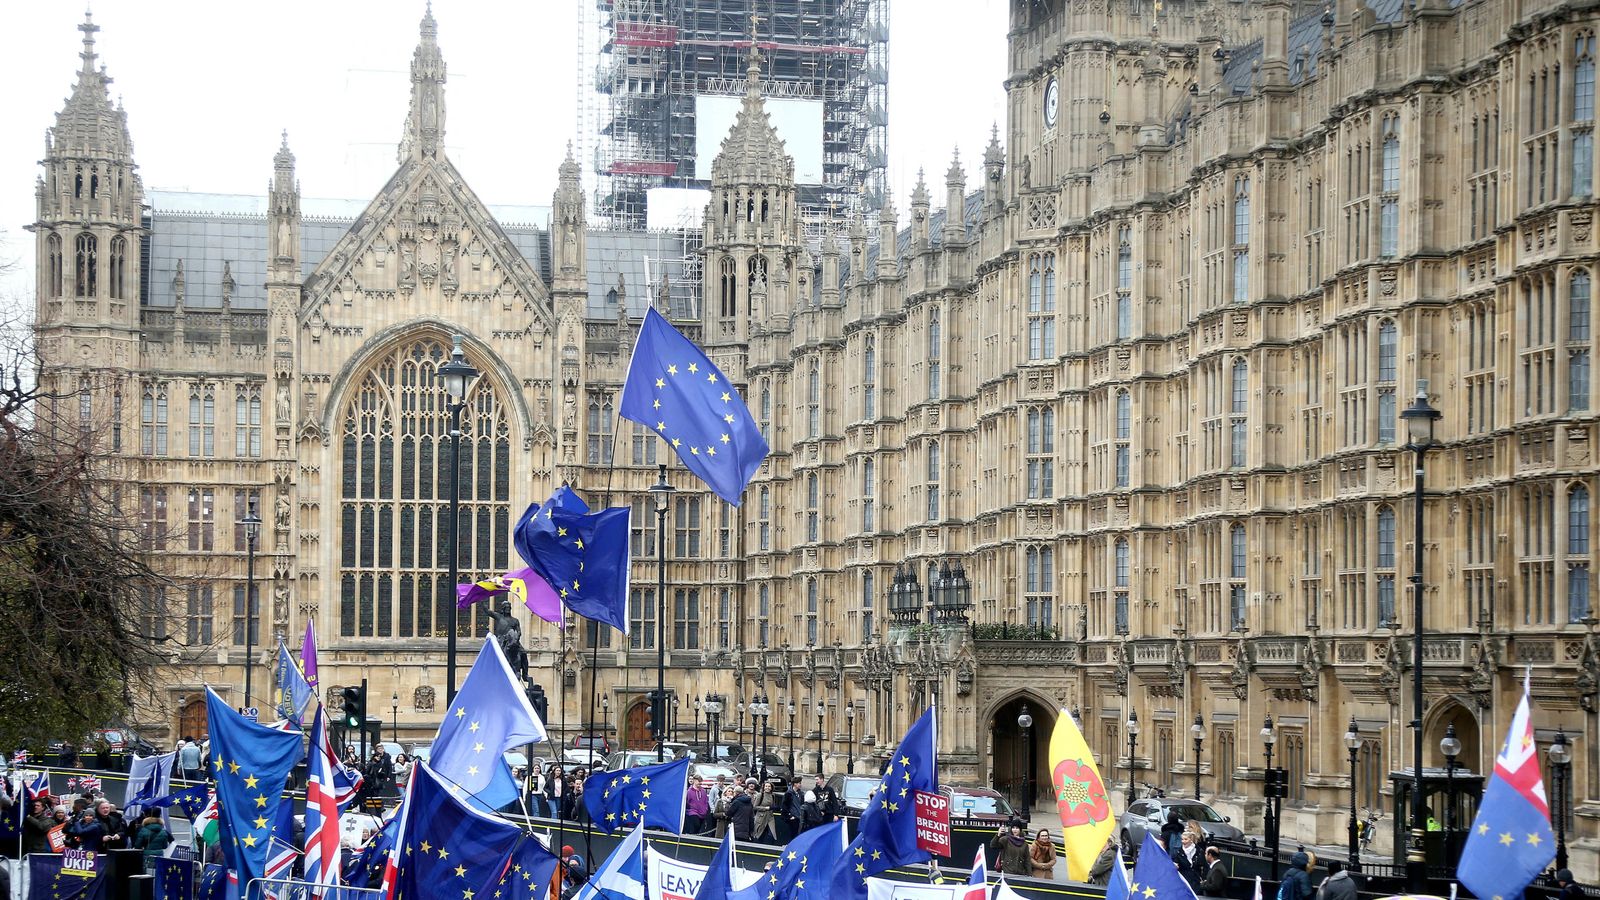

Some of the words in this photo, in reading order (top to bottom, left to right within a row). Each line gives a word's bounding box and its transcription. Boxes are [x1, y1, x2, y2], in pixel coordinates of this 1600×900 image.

[916, 793, 946, 810] STOP
[926, 809, 938, 817] THE
[916, 817, 948, 832] BREXIT
[917, 829, 948, 846] MESS!
[65, 849, 86, 860] VOTE
[64, 858, 94, 870] UKIP
[661, 872, 703, 896] LEAV
